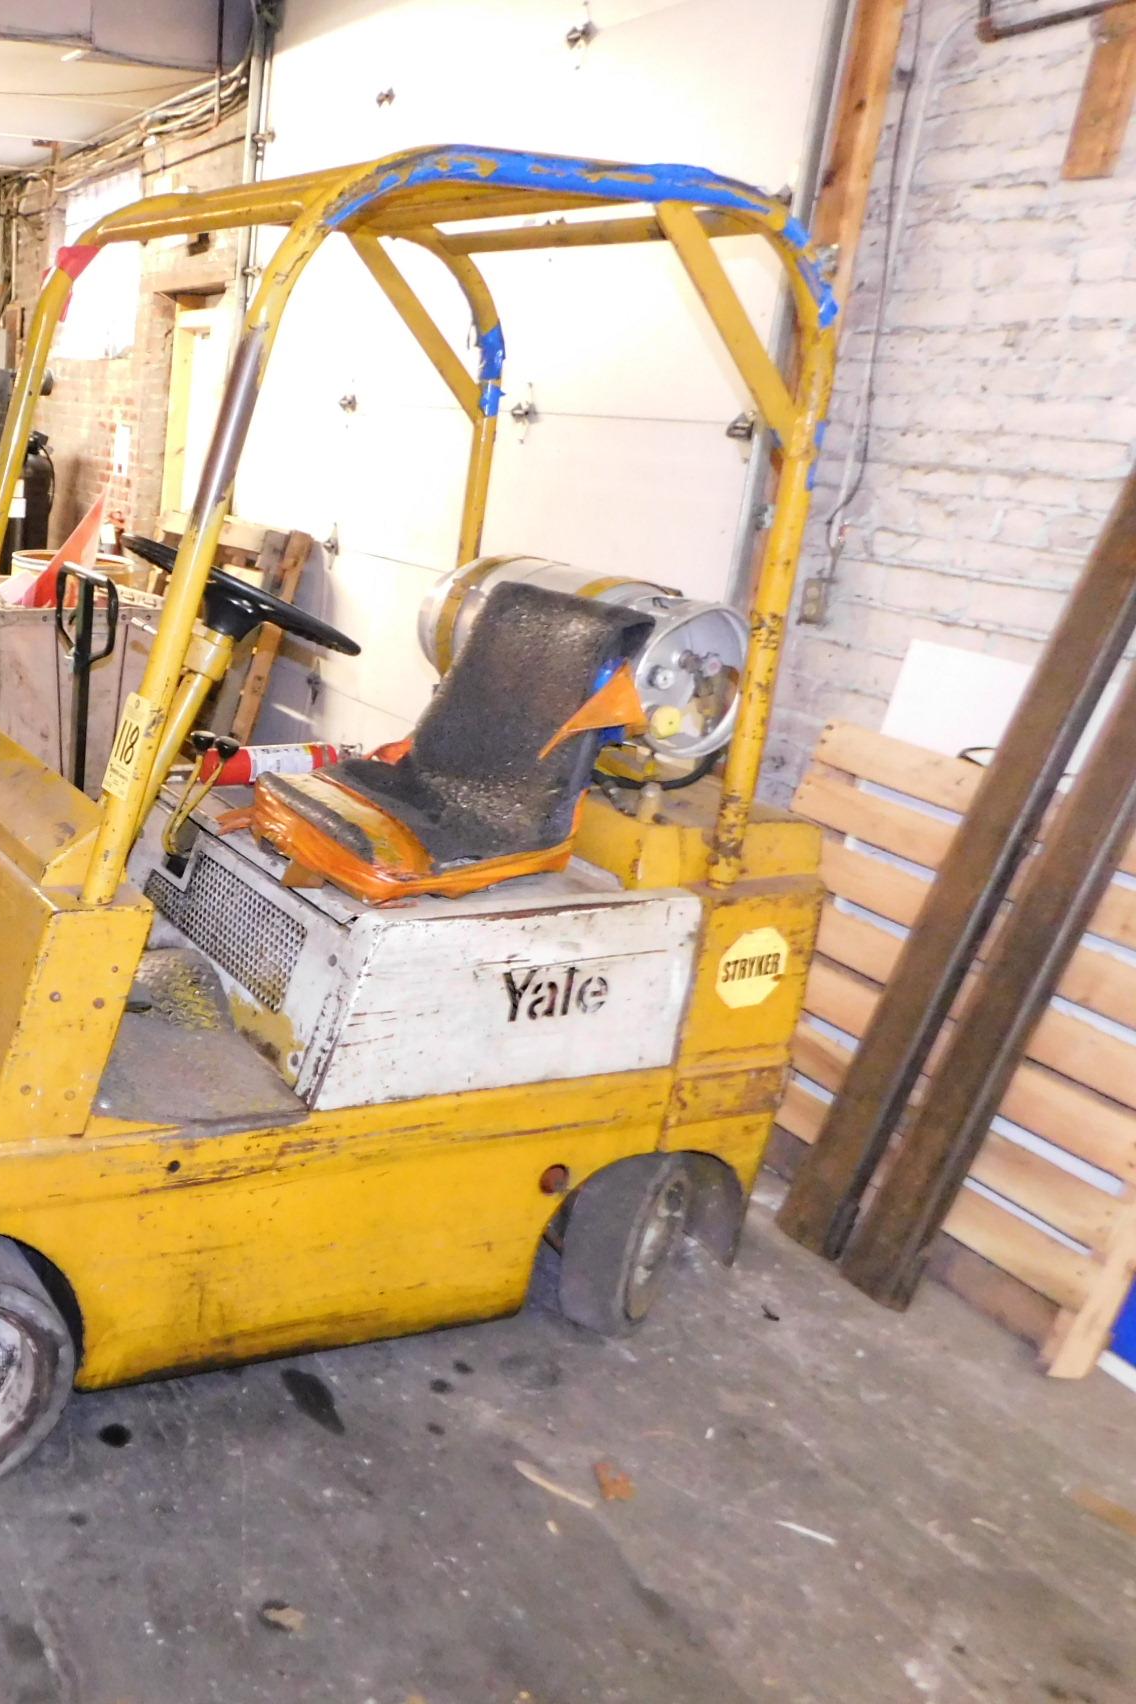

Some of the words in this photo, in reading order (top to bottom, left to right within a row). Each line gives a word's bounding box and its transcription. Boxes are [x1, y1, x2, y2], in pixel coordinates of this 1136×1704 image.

[114, 719, 140, 765] 118
[721, 952, 781, 983] STRYKER
[502, 966, 608, 1022] Yale
